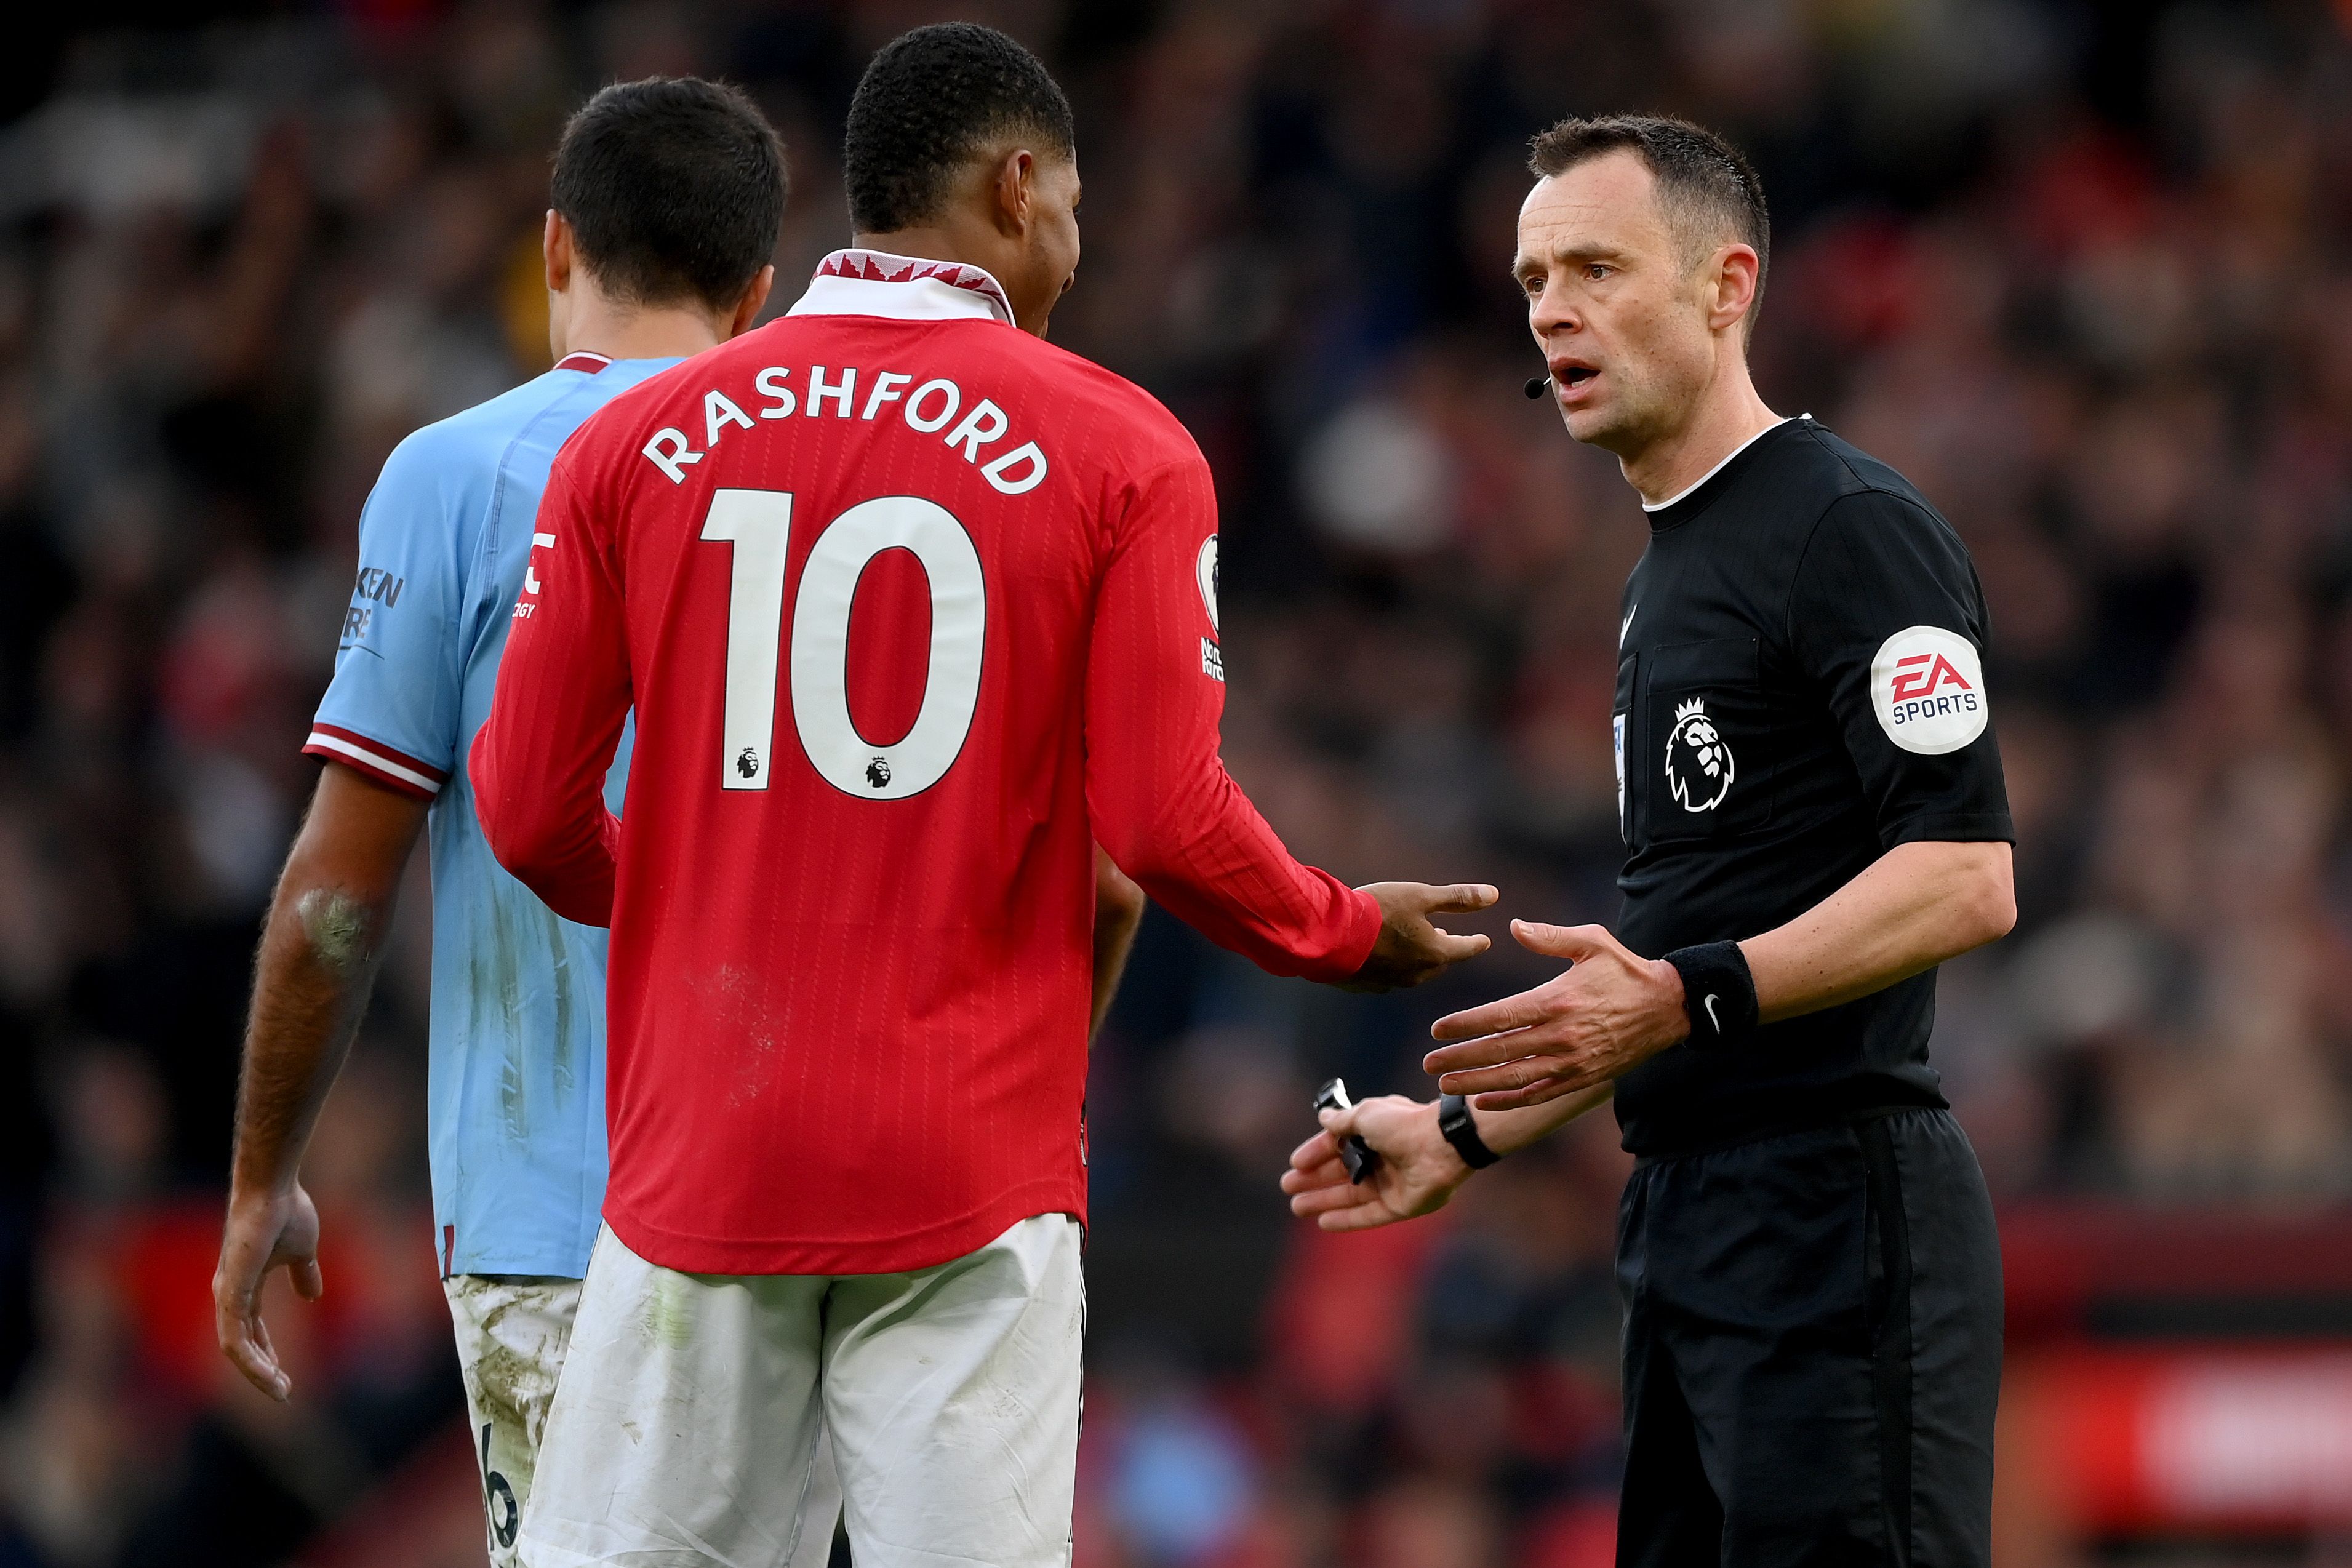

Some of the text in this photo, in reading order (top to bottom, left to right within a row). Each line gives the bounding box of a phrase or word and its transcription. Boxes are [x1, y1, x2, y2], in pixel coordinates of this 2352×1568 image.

[642, 365, 1047, 495] RASHFORD
[699, 487, 986, 801] 10
[1890, 652, 1972, 704] EA
[1893, 693, 1977, 725] SPORTS
[482, 1422, 518, 1550] 6
